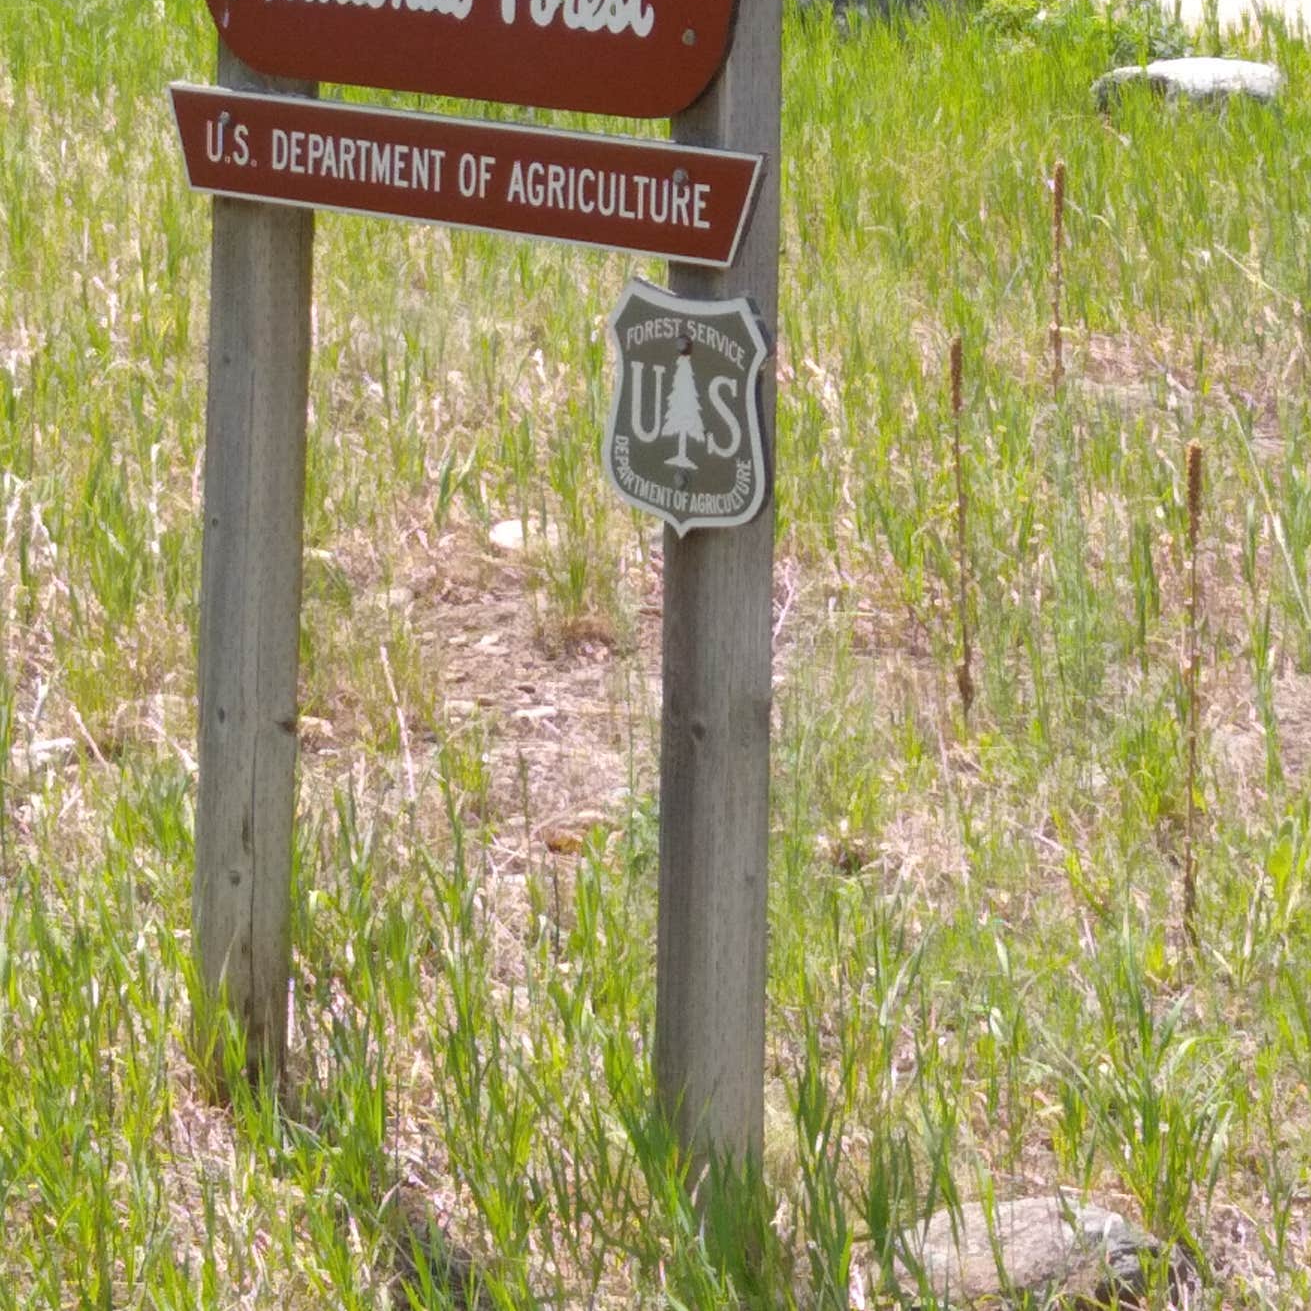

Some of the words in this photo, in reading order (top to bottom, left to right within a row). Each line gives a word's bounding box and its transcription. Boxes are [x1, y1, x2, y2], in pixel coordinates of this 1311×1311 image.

[205, 118, 257, 168] U.S.
[272, 129, 445, 192] DEPARTMENT
[459, 152, 496, 199] OF
[507, 160, 711, 230] AGRICULTURE
[626, 317, 683, 351] FOREST
[686, 320, 746, 371] SERVICE
[614, 435, 673, 510] DEPARTMENT
[673, 492, 689, 512] OF
[689, 458, 753, 514] AGRICULTURE
